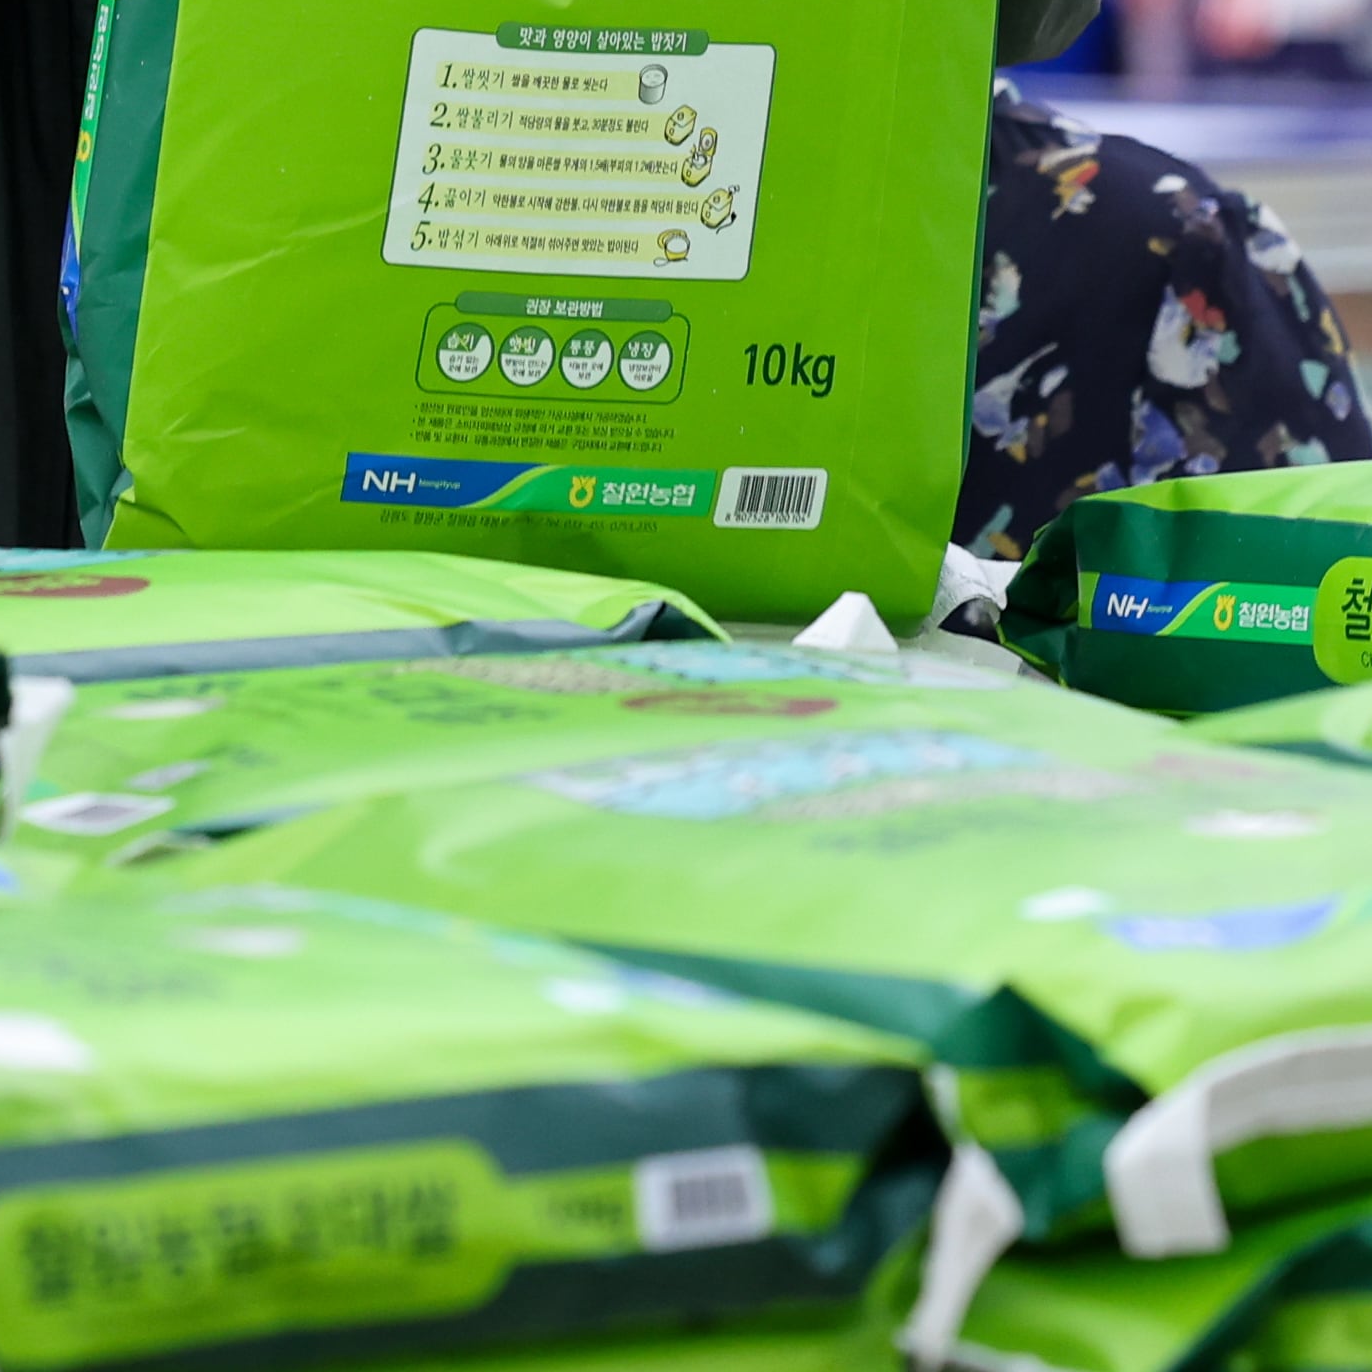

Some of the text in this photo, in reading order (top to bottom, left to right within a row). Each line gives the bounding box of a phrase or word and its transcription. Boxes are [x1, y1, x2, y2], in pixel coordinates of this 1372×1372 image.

[519, 27, 688, 52] 맛과 영양이 살아있는 밥짓기
[439, 64, 457, 89] 1.
[462, 68, 504, 91] 쌀씻기
[533, 75, 559, 91] 깨끗한
[583, 77, 608, 92] 씻는다
[430, 102, 451, 128] 2.
[457, 107, 514, 130] 쌀불리기
[422, 143, 444, 175] 3.
[450, 149, 492, 171] 물붓기
[418, 182, 439, 214] 4.
[444, 188, 486, 208] 끓이기
[410, 221, 432, 252] 5.
[438, 228, 479, 250] 밥섞기
[526, 298, 603, 318] 권장 보관방법
[570, 339, 595, 356] 통풍
[628, 341, 654, 358] 냉장
[744, 342, 836, 398] 10kg
[362, 470, 416, 493] NH
[602, 482, 696, 506] 철원농협
[1107, 593, 1150, 619] NH
[1238, 601, 1310, 631] 철원농협
